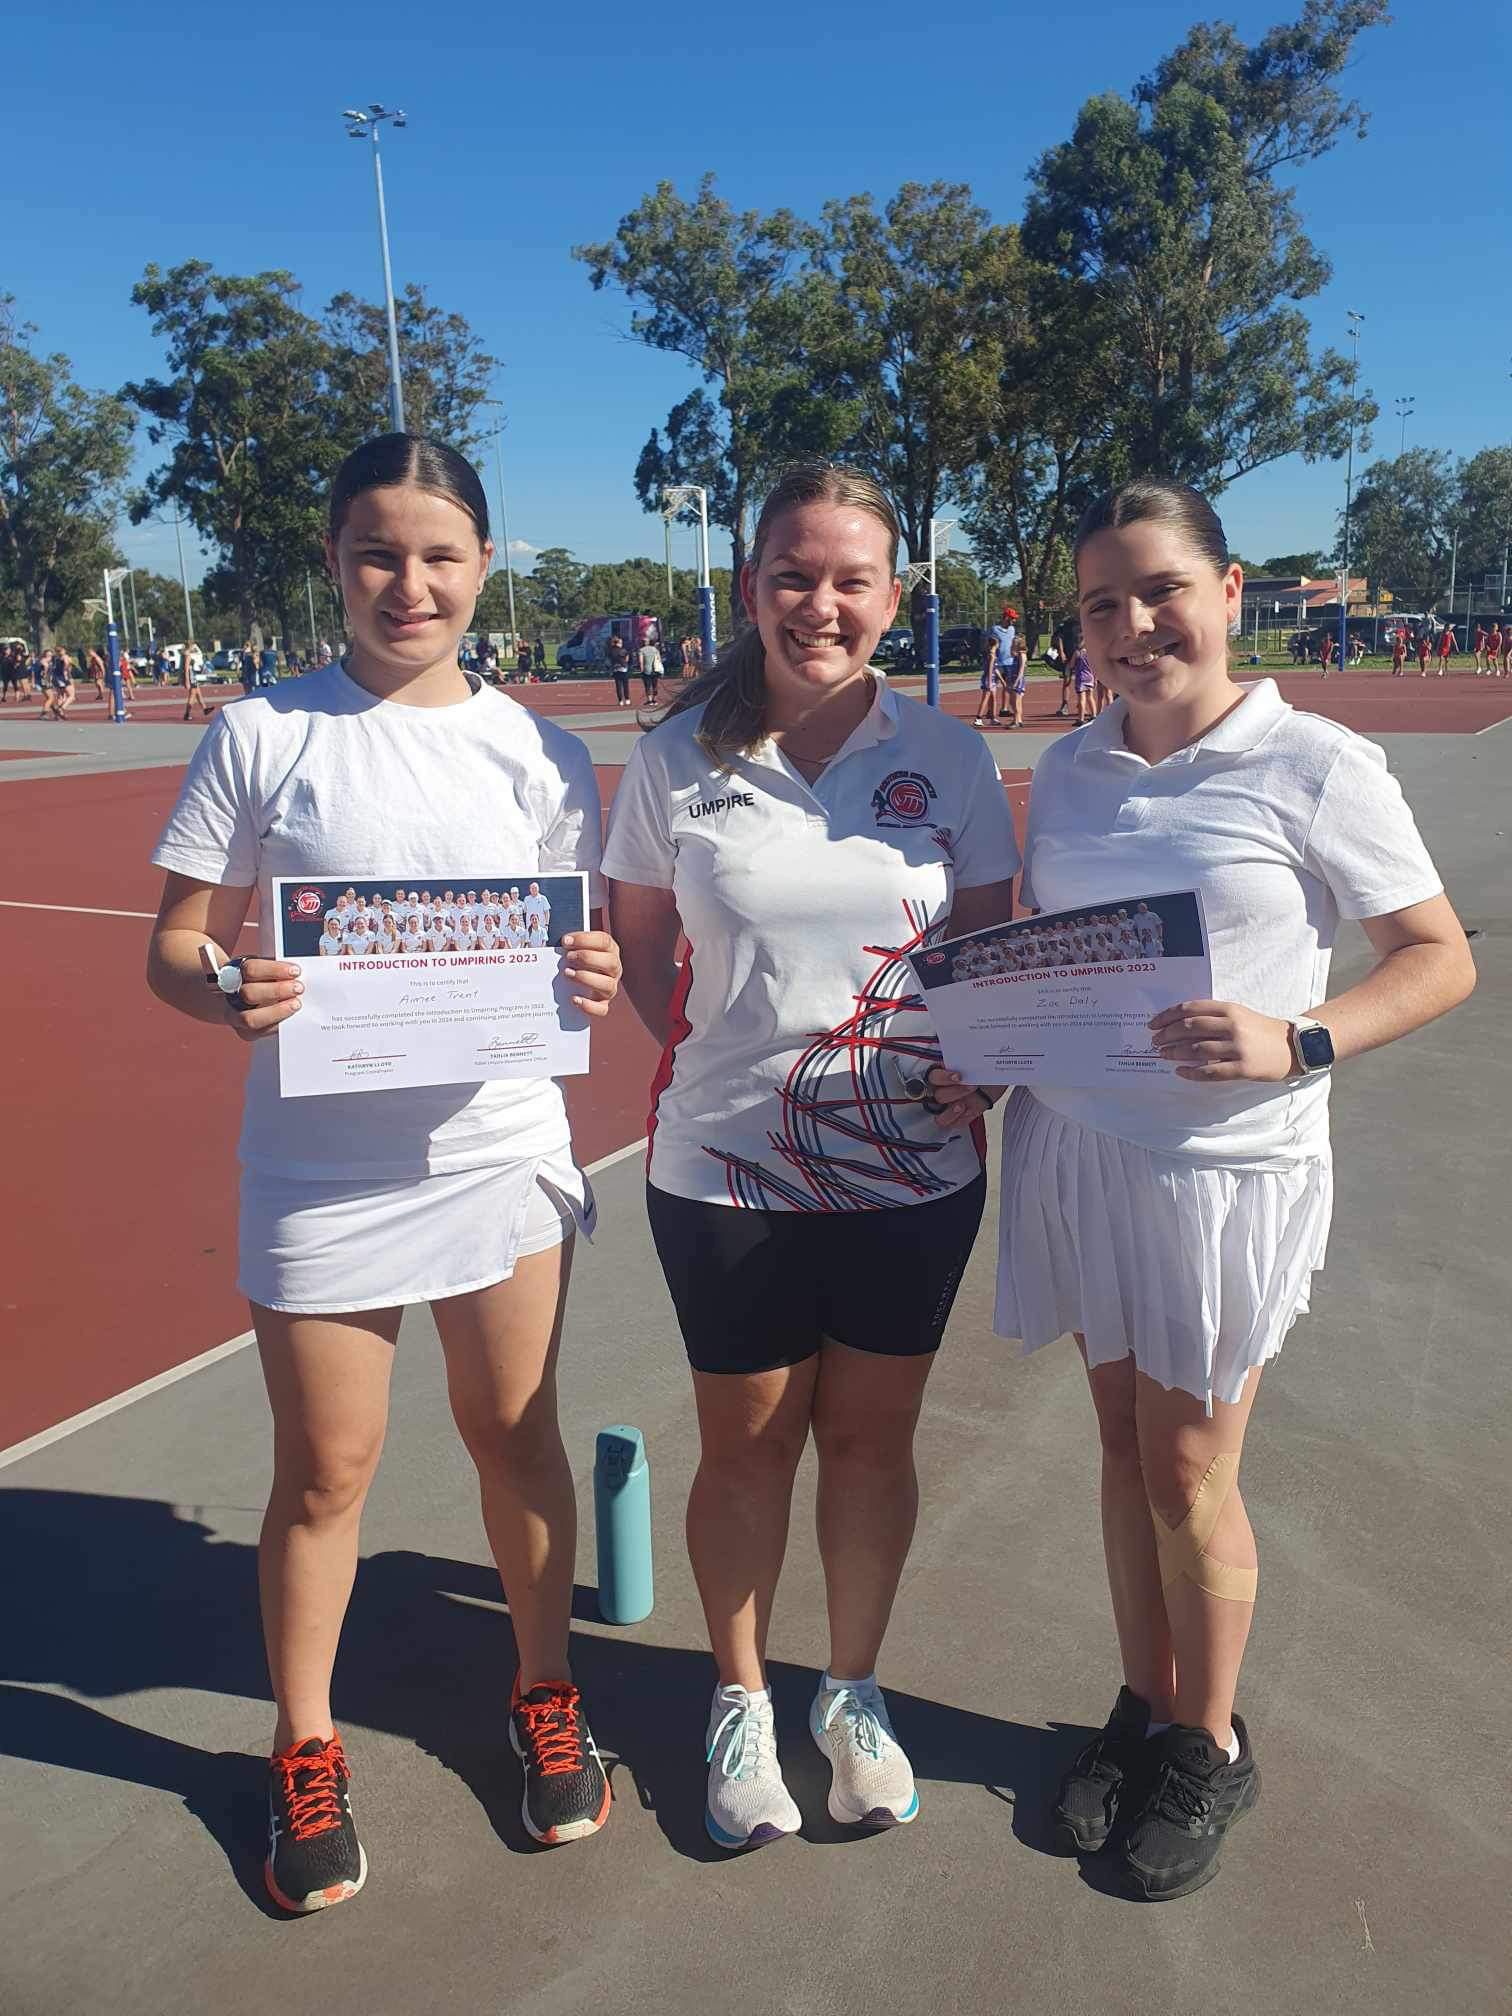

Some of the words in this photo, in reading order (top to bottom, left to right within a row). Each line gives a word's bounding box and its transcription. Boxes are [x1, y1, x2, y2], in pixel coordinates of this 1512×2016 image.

[688, 792, 755, 819] UMPIRE
[339, 958, 428, 971] INTRODUCTION
[432, 958, 447, 967] TO
[450, 955, 506, 966] UMPIRING
[509, 953, 538, 964] 2023
[972, 970, 1051, 989] INTRODUCTION
[1054, 969, 1068, 978] TO
[1070, 965, 1124, 977] UMPIRING
[1126, 962, 1156, 972] 2023
[1069, 995, 1098, 1008] Daly
